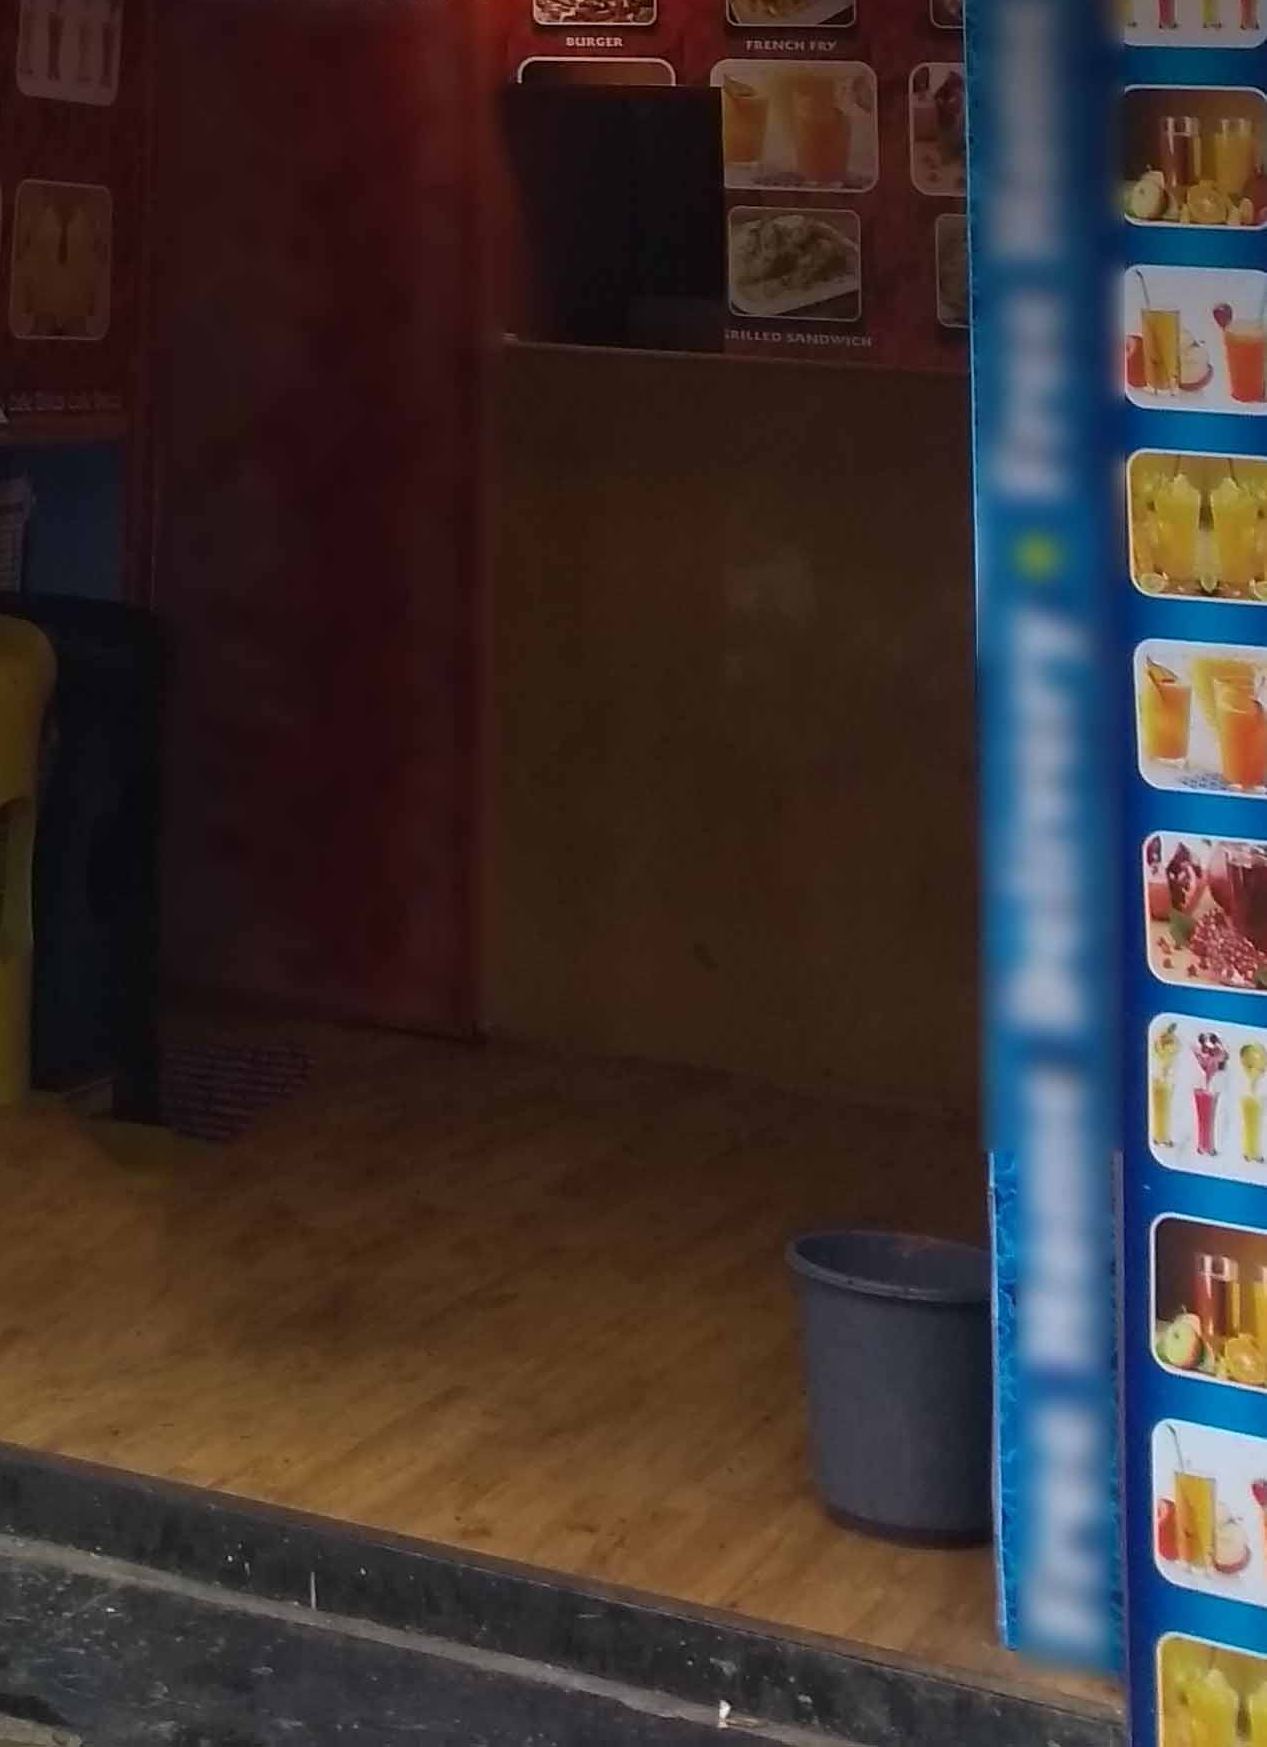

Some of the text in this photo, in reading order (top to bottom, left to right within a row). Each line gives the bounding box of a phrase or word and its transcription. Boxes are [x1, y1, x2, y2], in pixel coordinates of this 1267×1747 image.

[565, 36, 623, 48] BURGER
[745, 39, 838, 52] FRENCH FRY
[786, 331, 872, 348] SANDWICH
